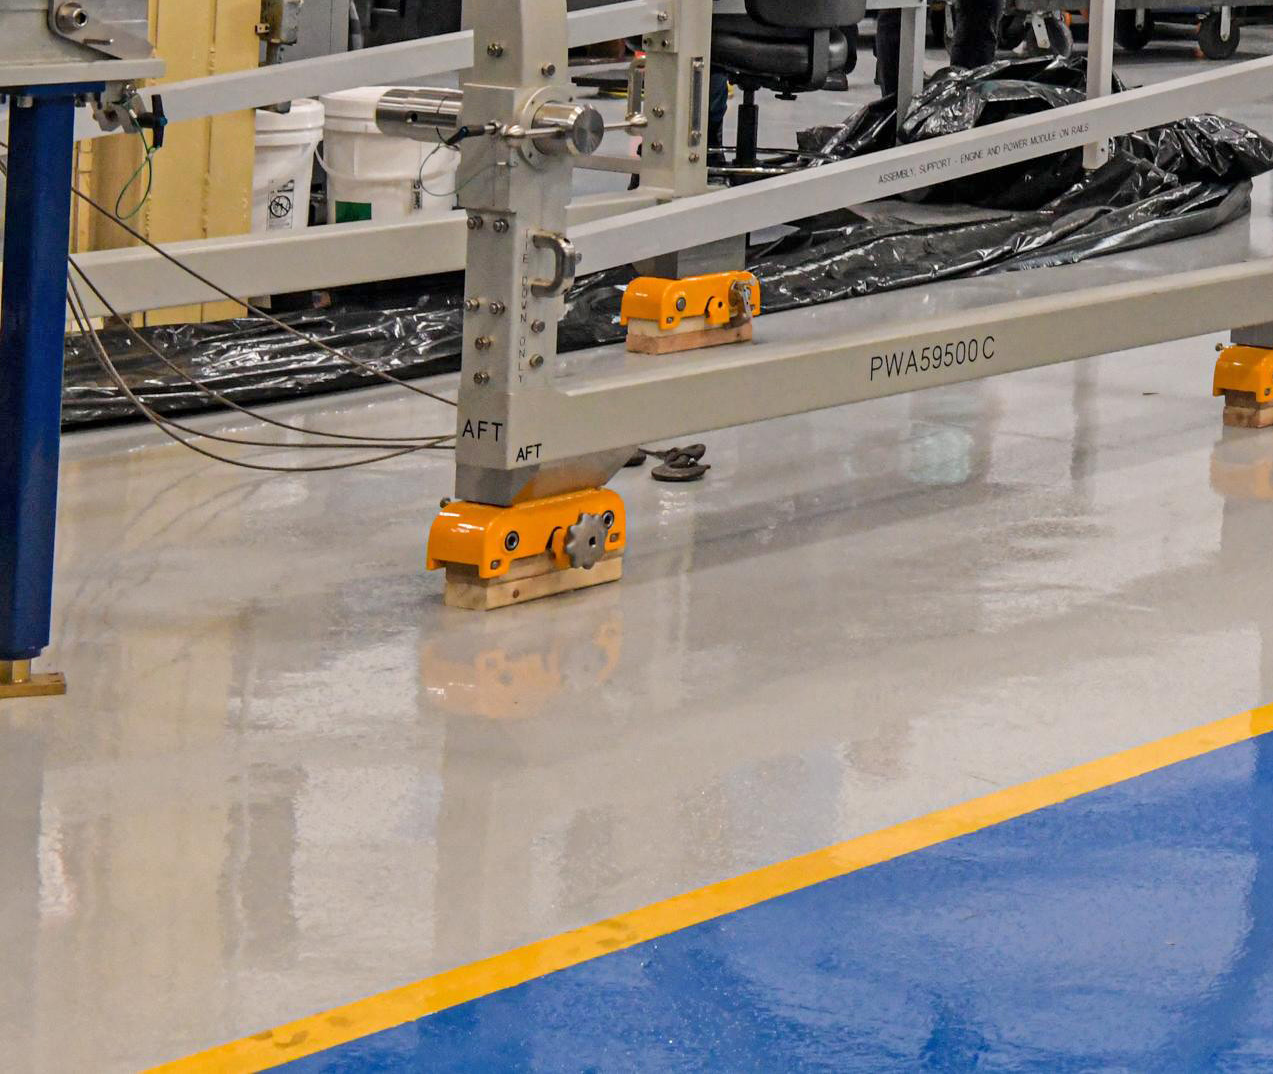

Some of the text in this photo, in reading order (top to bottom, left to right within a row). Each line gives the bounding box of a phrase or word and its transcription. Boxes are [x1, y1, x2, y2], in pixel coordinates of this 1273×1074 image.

[919, 157, 952, 175] SUPPORT
[960, 148, 984, 166] ENGINE
[987, 145, 1001, 158] AND
[1003, 139, 1028, 155] POWER
[1030, 133, 1056, 147] MODULE
[1059, 128, 1070, 140] ON
[1071, 123, 1089, 136] RAILS
[520, 276, 528, 323] DOWN
[462, 417, 503, 442] AFT
[515, 443, 542, 464] AFT
